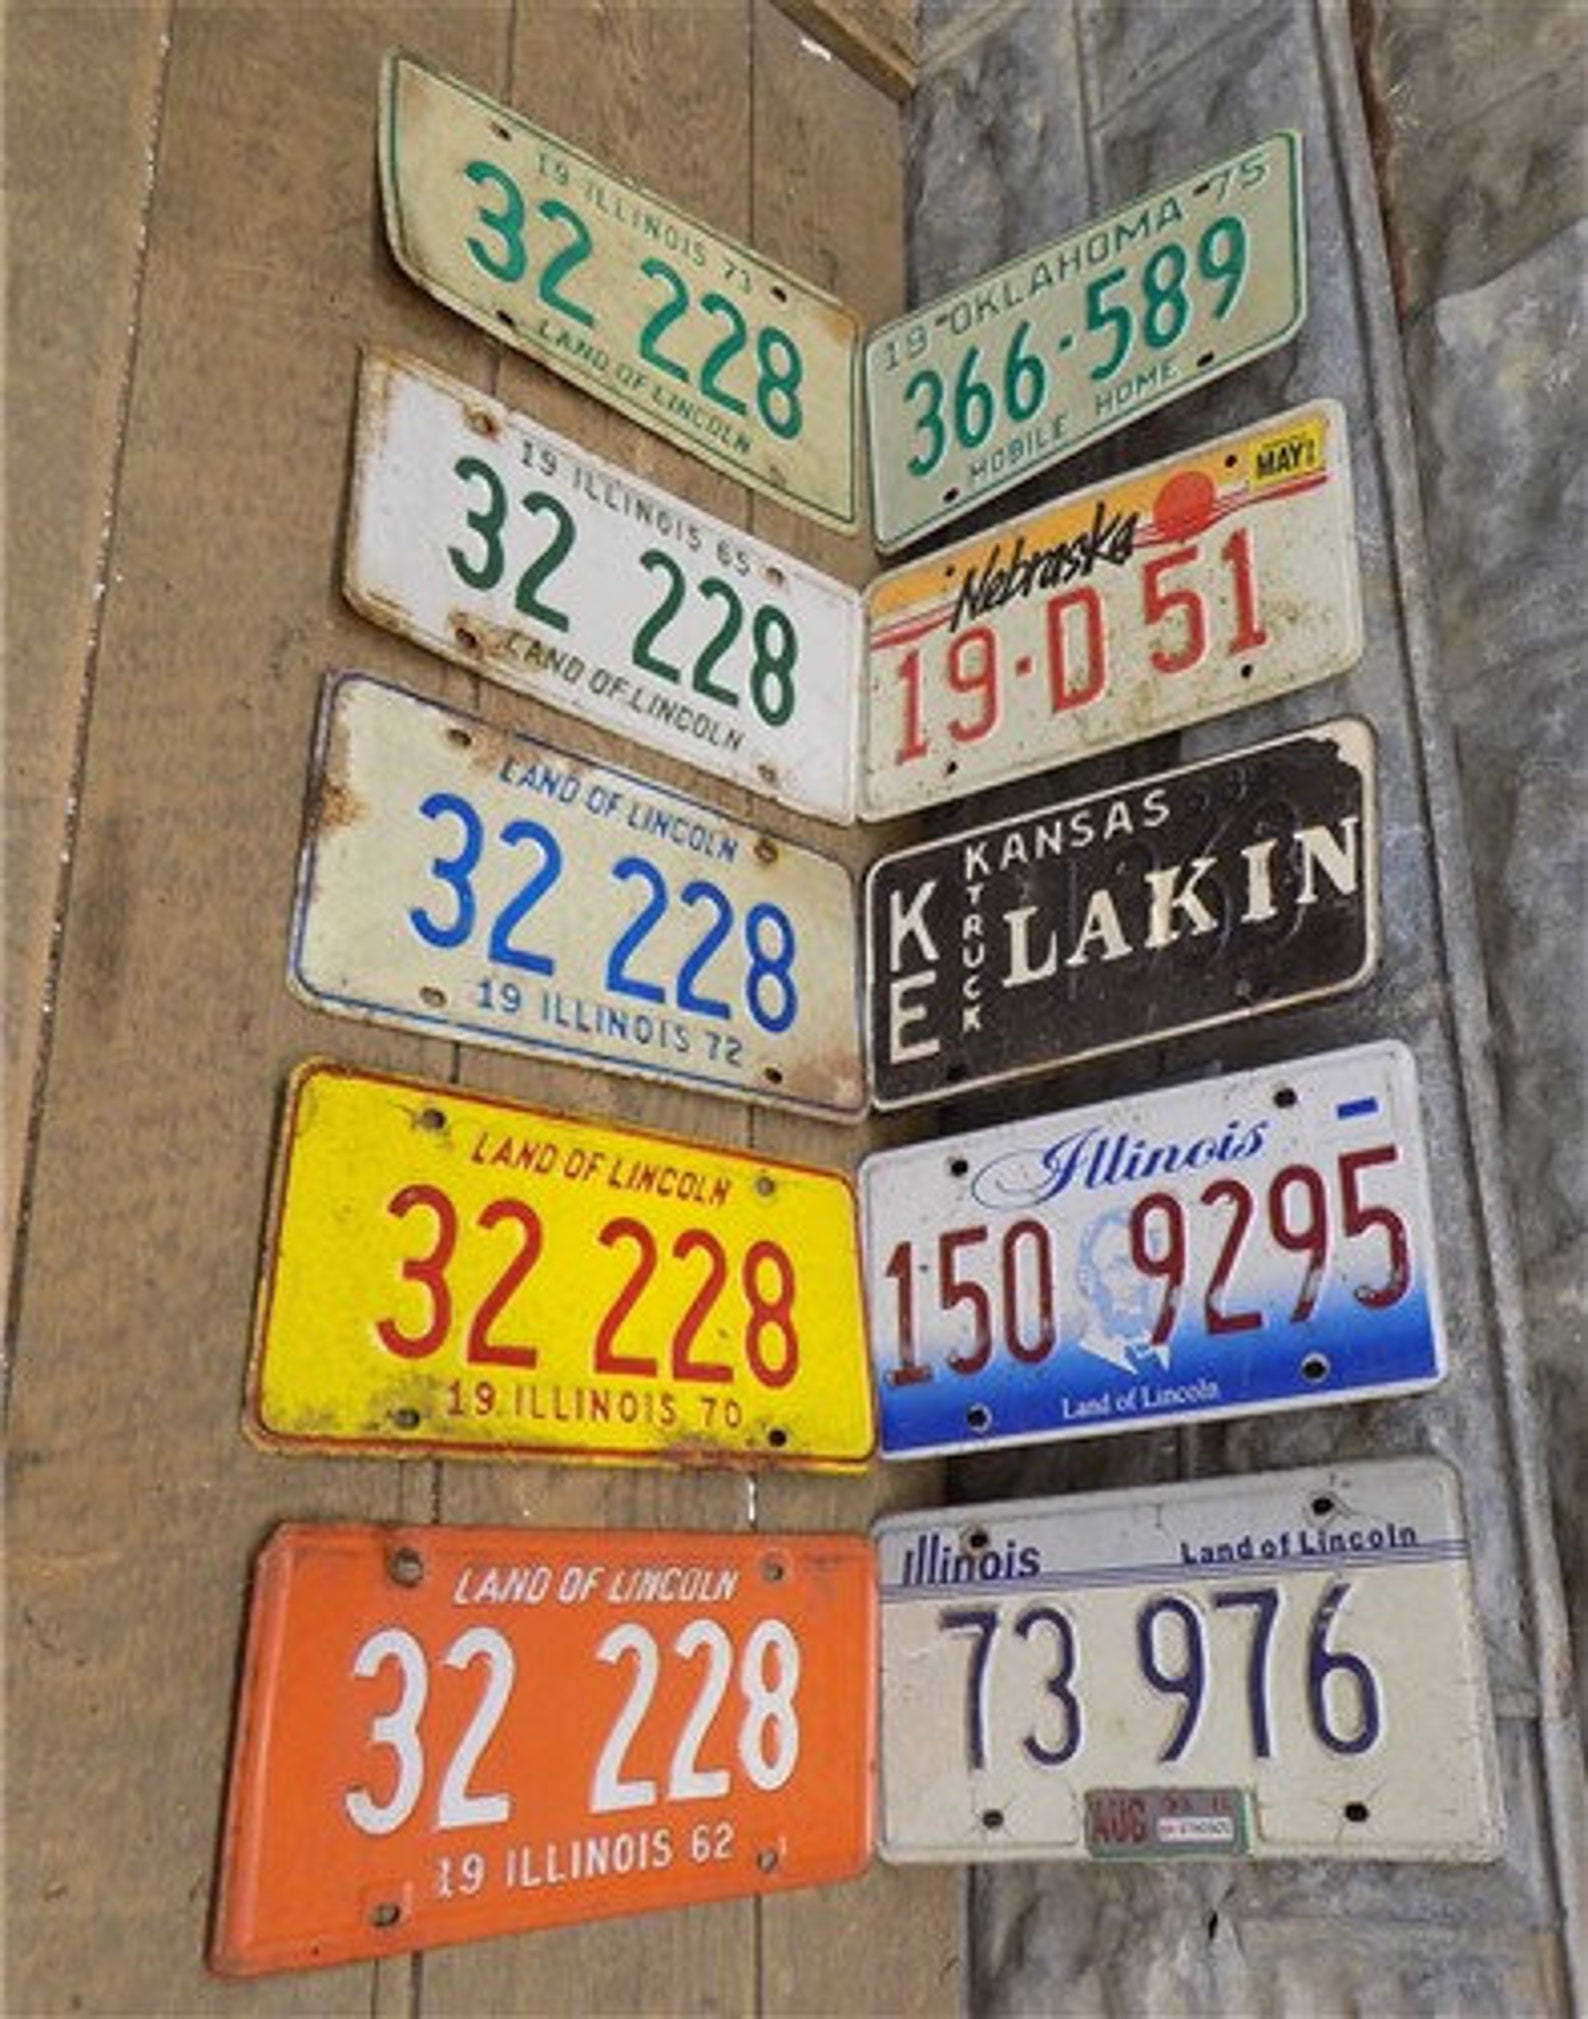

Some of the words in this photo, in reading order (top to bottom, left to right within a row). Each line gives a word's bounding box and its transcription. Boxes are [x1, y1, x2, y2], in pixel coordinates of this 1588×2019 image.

[538, 153, 569, 187] 19
[585, 183, 706, 266] ILLINOIS
[885, 325, 928, 372] 19
[949, 198, 1184, 336] OKLAHOMA
[1213, 160, 1267, 202] 75
[463, 160, 596, 329] 32
[639, 257, 802, 440] 228
[539, 320, 607, 371] LAND
[616, 368, 648, 392] OF
[654, 385, 752, 454] LINCOLN
[969, 415, 1068, 480] MOBILE
[1095, 363, 1179, 414] HOME
[520, 440, 558, 477] 19
[573, 465, 702, 551] ILLINOIS
[716, 540, 751, 575] 65
[1256, 442, 1303, 479] MAY
[448, 455, 576, 633] 32
[632, 548, 797, 727] 228
[950, 501, 1140, 632] Nebraska
[1142, 528, 1267, 675] 51
[507, 629, 581, 685] LAND
[587, 669, 627, 700] OF
[631, 686, 745, 752] LINCOLN
[500, 755, 579, 803] LAND
[585, 784, 618, 817] OF
[628, 802, 739, 863] LINCOLN
[964, 788, 1171, 882] KANSAS
[410, 792, 562, 977] 32
[606, 857, 798, 1034] 228
[1001, 817, 1361, 988] LAKIN
[477, 979, 522, 1014] 19
[541, 992, 690, 1055] ILLINOIS
[705, 1031, 744, 1066] 72
[471, 1132, 561, 1177] LAND
[563, 1150, 603, 1184] OF
[609, 1156, 732, 1206] LINCOLN
[970, 1119, 1270, 1211] Illinois
[376, 1184, 543, 1370] 32
[594, 1217, 799, 1390] 228
[886, 1219, 1055, 1387] 150
[1130, 1144, 1411, 1346] 9295
[446, 1382, 496, 1418] 19
[515, 1385, 678, 1427] ILLINOIS
[701, 1397, 742, 1430] 70
[1063, 1394, 1112, 1419] Land
[1117, 1390, 1138, 1412] of
[1142, 1380, 1221, 1408] Lincoln
[453, 1566, 551, 1606] LAND
[558, 1566, 603, 1603] OF
[608, 1565, 739, 1603] LINCOLN
[902, 1533, 1041, 1587] Illinois
[1181, 1537, 1254, 1566] Land
[1260, 1532, 1291, 1558] of
[1300, 1524, 1418, 1556] Lincoln
[345, 1627, 517, 1837] 32
[589, 1618, 800, 1813] 228
[939, 1606, 1081, 1770] 73
[1138, 1582, 1381, 1764] 976
[436, 1853, 484, 1900] 19
[507, 1829, 672, 1887] ILLINOIS
[691, 1823, 734, 1862] 62
